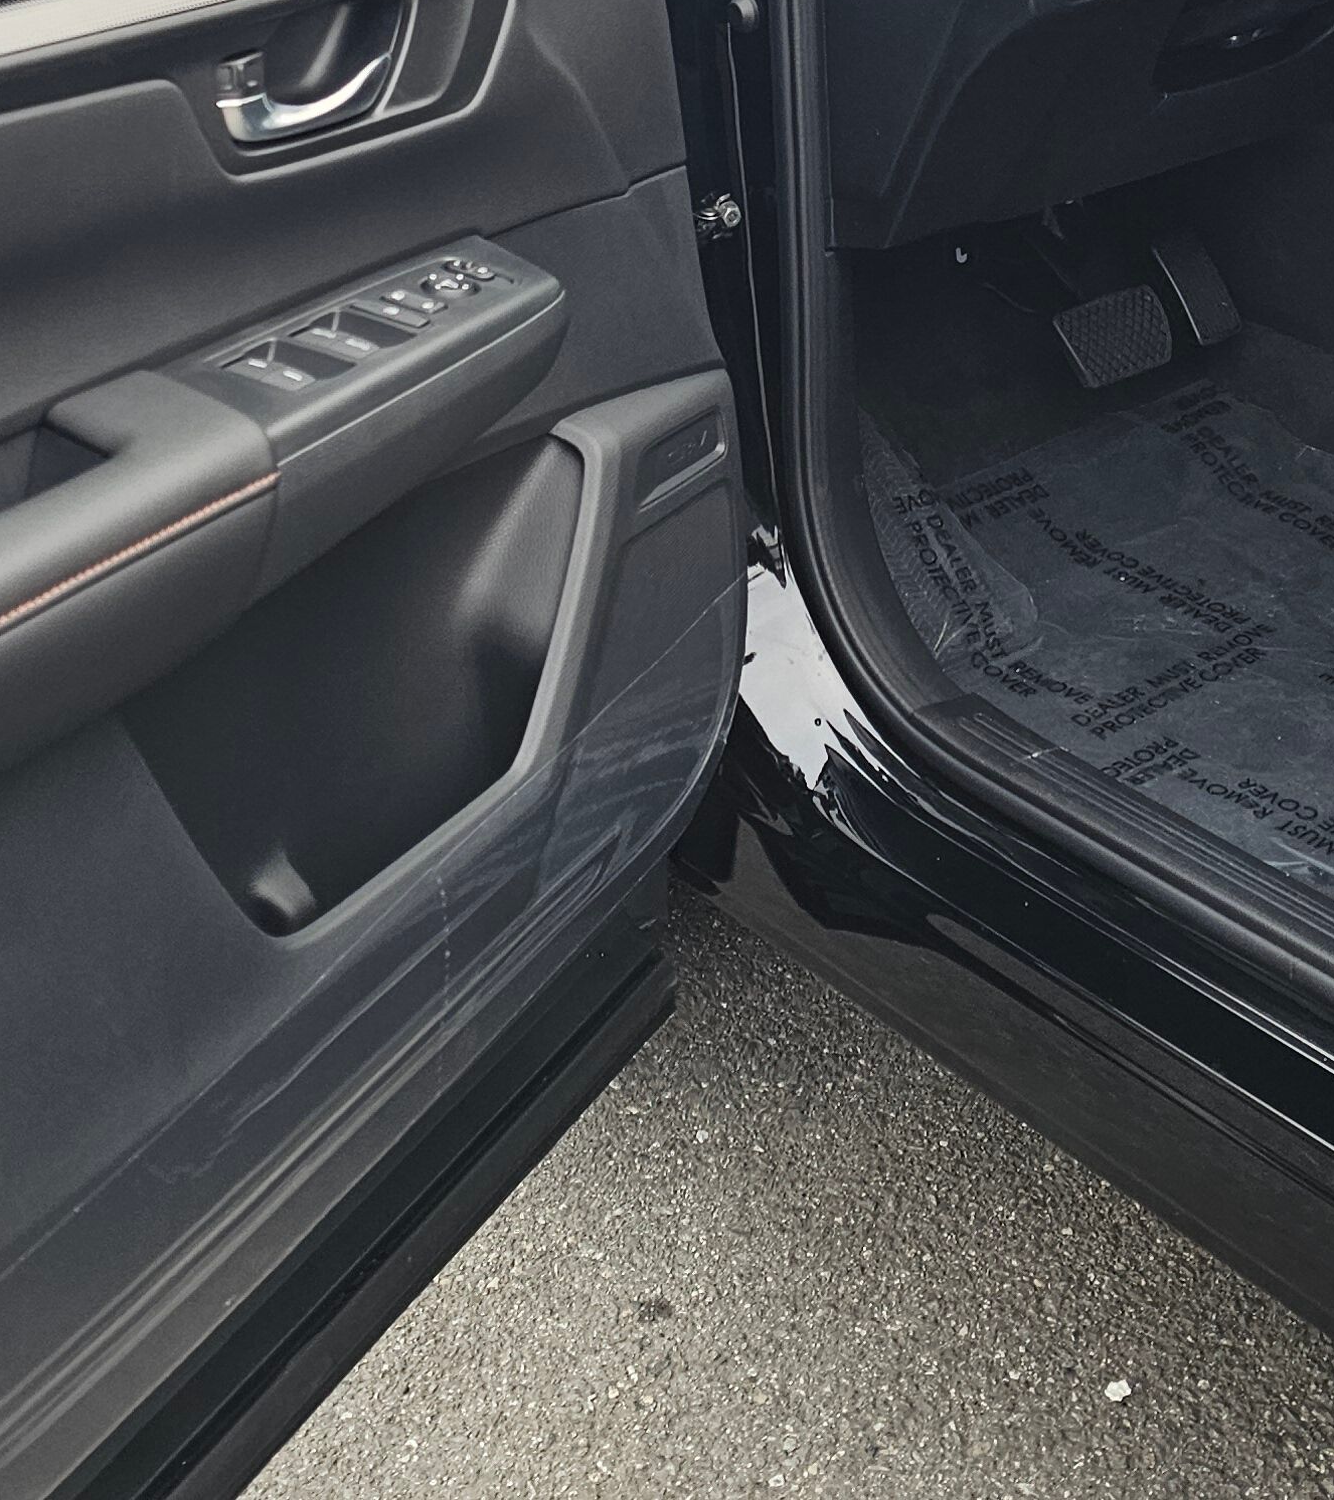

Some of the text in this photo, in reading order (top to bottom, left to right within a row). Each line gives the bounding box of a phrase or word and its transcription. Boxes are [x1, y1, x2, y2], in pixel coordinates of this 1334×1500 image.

[1180, 432, 1279, 516] PROTECTIVE
[1196, 425, 1260, 484] DEALER
[1258, 489, 1313, 514] MUST
[1027, 507, 1102, 569] REMOVE
[1074, 527, 1140, 569] COVER
[911, 521, 1037, 697] PROTECTIVE COVER
[927, 514, 977, 594] DEALER
[976, 600, 1010, 659] MUST
[1008, 659, 1094, 704] REMOVE
[1070, 685, 1145, 727] DEALER
[1090, 647, 1267, 740] PROTECTIVE COVER
[1100, 735, 1179, 778] PROTEC
[1176, 767, 1274, 821] REMOVE
[1238, 778, 1318, 822] COVER
